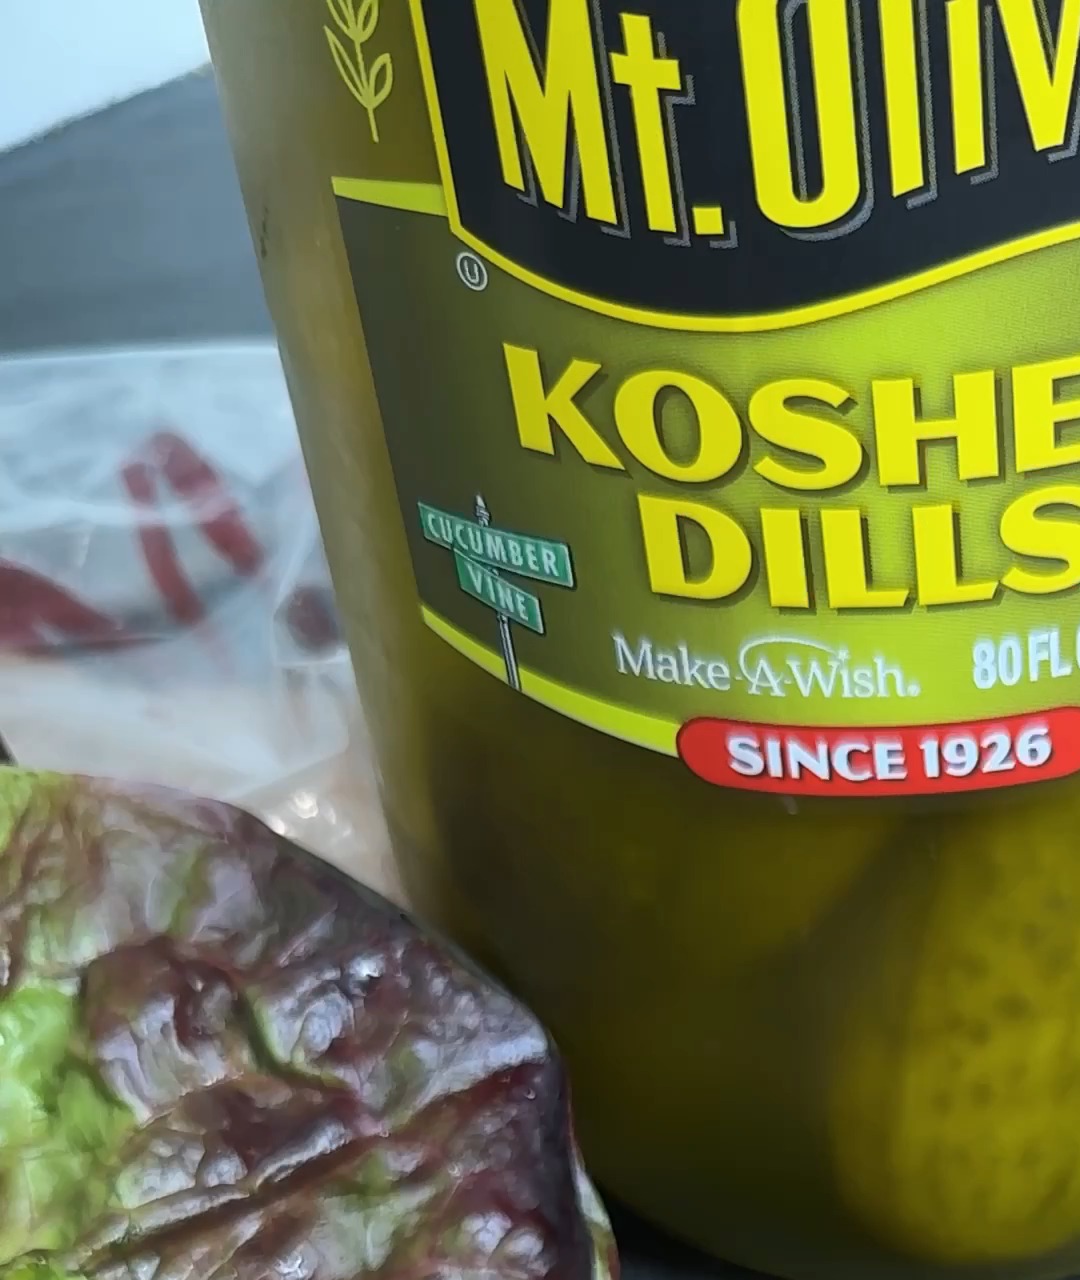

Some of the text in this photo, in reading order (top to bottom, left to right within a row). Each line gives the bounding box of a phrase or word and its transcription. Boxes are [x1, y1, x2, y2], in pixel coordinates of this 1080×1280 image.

[474, 0, 725, 236] Mt.
[427, 513, 560, 578] CUCUMBER
[465, 562, 530, 622] VINE
[972, 635, 1022, 690] 80
[1027, 625, 1072, 682] FL
[727, 722, 1053, 781] SINCE 1926
